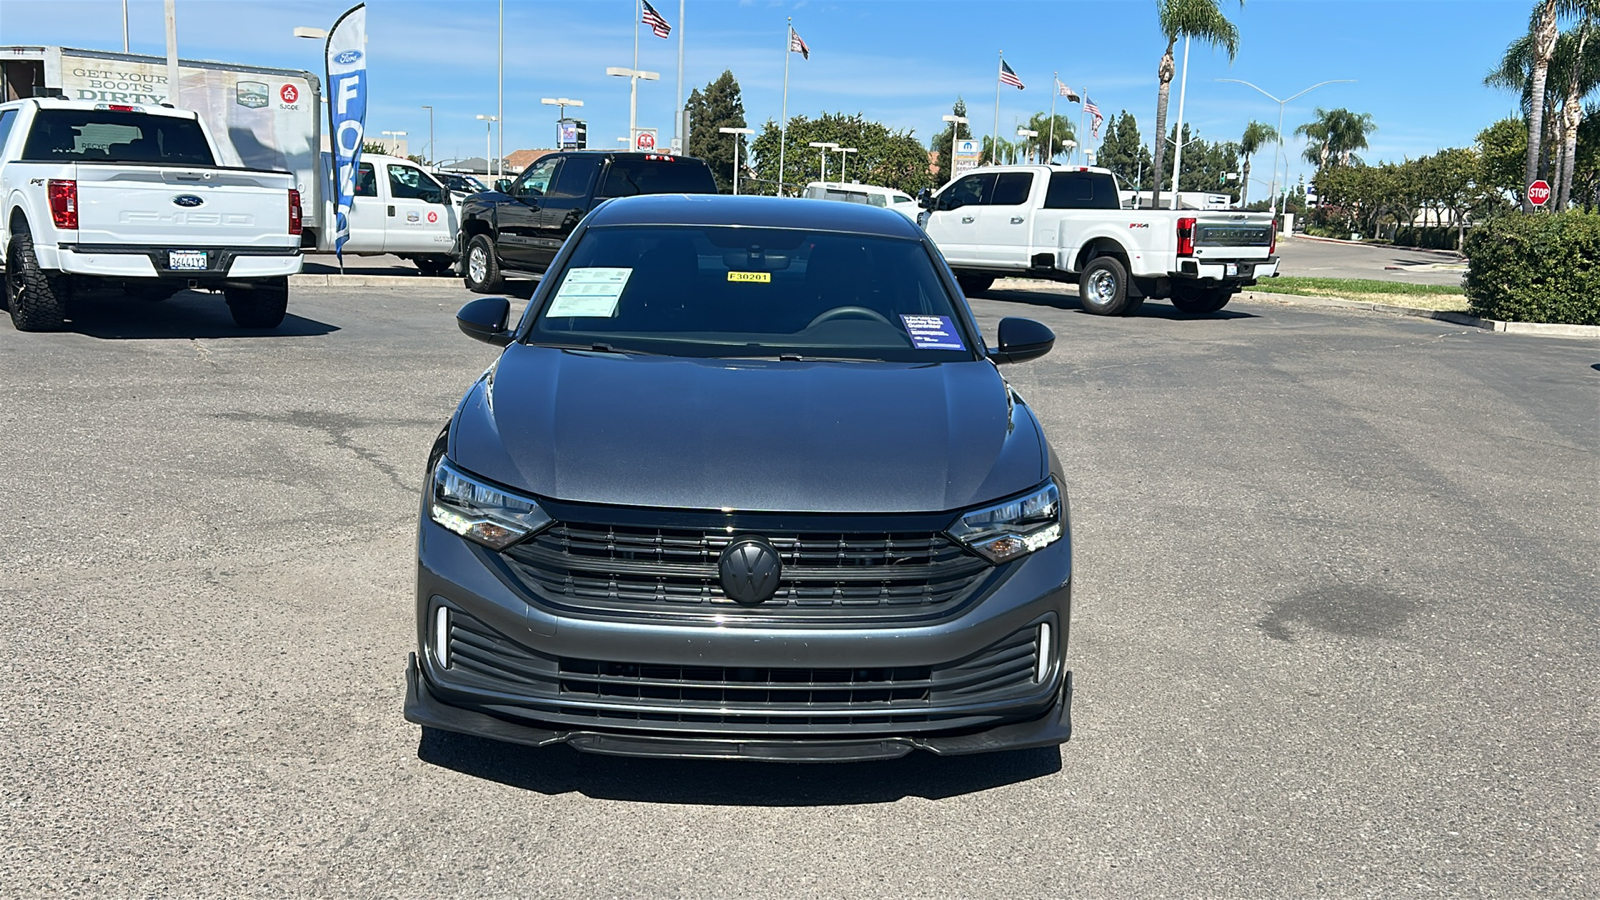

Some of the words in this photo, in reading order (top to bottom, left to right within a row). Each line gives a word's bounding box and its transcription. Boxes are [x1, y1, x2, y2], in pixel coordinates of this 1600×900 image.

[339, 52, 358, 63] Ford
[73, 68, 112, 79] GET
[117, 72, 168, 84] YOUR
[89, 79, 153, 93] BOOTS
[77, 89, 167, 105] DIRTY
[1529, 188, 1549, 198] STOP
[119, 210, 254, 226] F-150
[171, 257, 206, 267] 36441Y3
